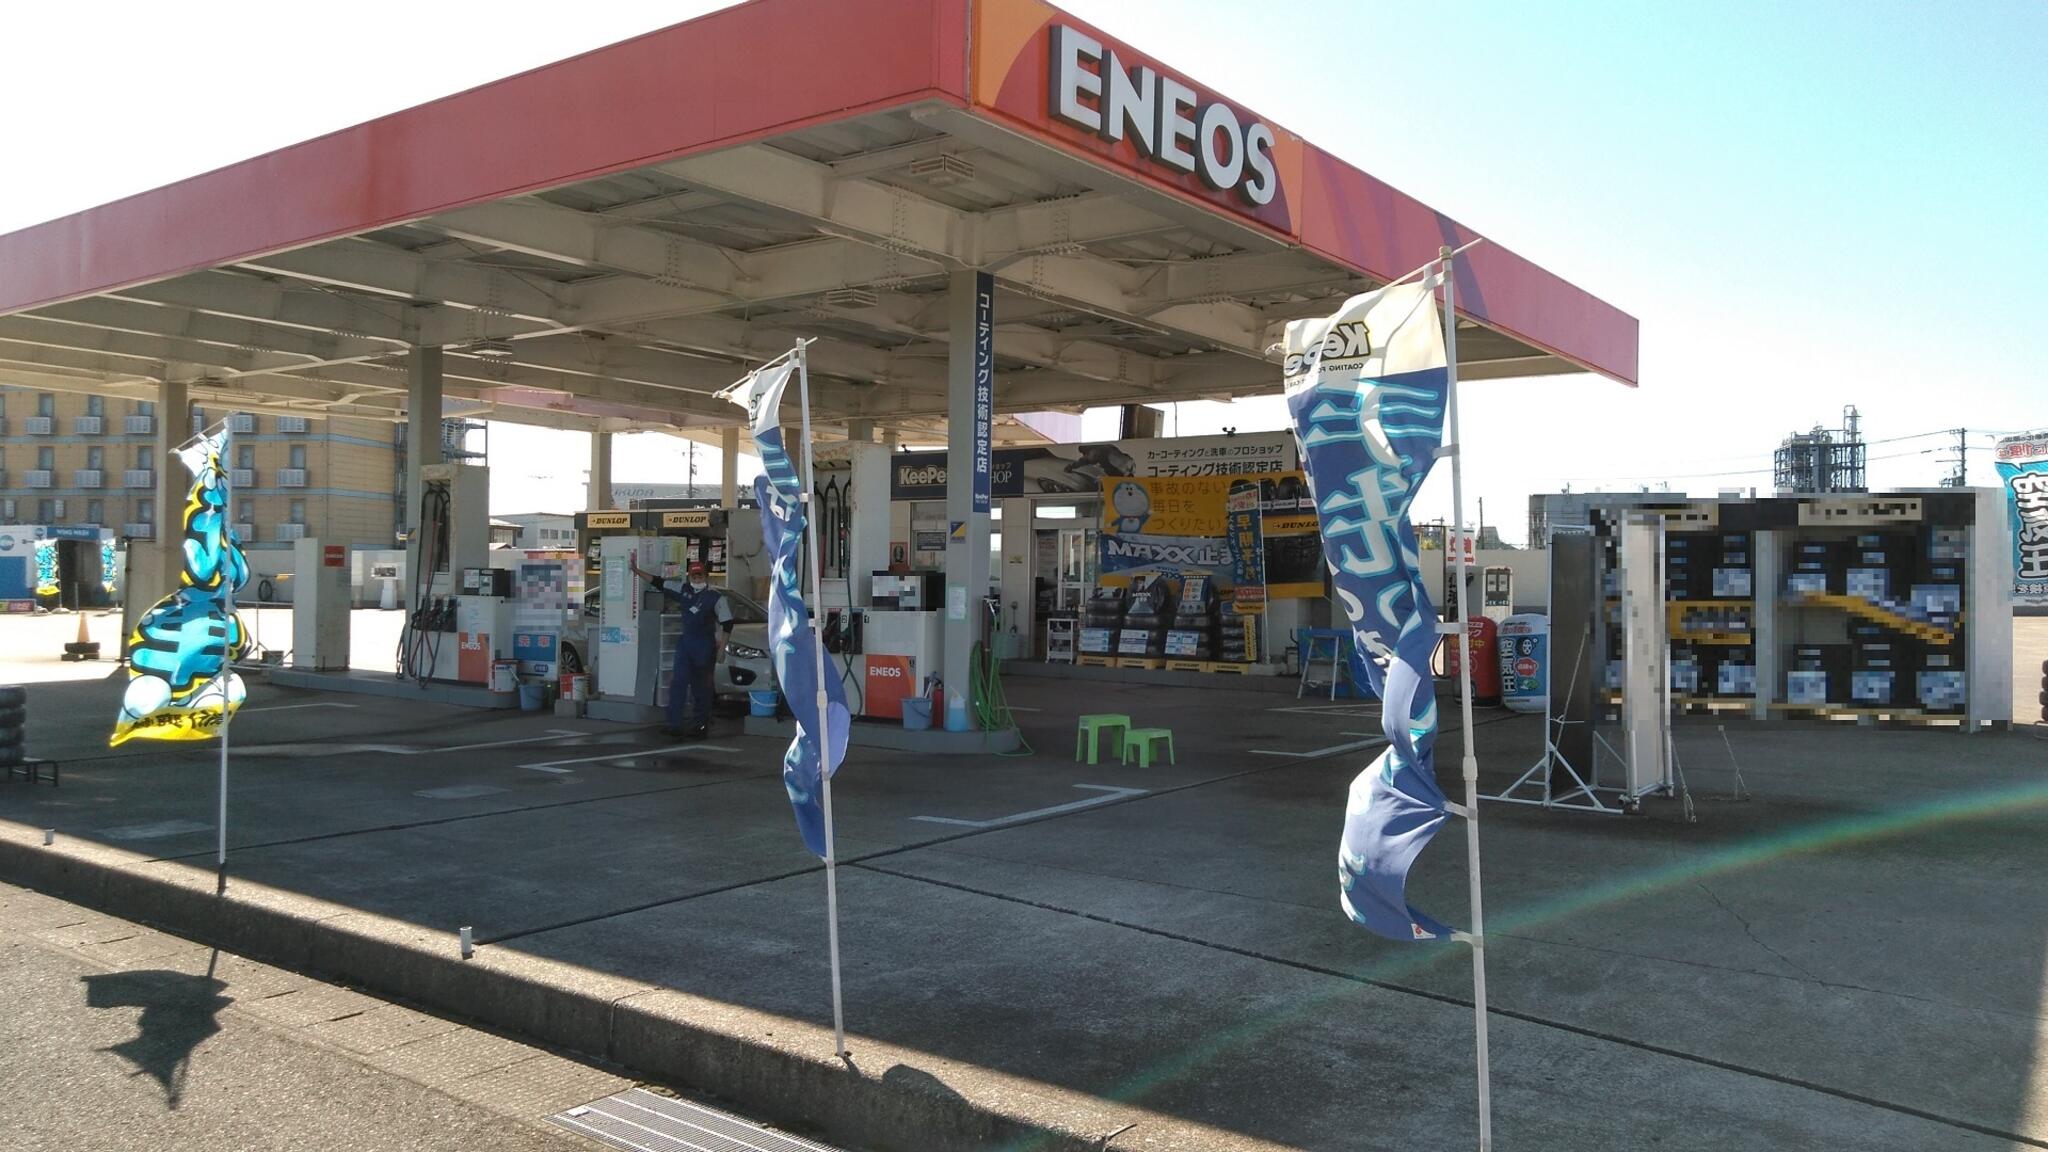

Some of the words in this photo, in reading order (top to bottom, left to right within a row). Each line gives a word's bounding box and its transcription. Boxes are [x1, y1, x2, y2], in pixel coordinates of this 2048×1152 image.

[1053, 24, 1276, 206] ENEOS
[976, 292, 990, 473] コーティング技術認定店
[1147, 444, 1283, 459] カーコーティングと洗車のプロショップ
[900, 465, 947, 485] KeePe
[1147, 460, 1283, 477] コーティング技術認定店
[1151, 481, 1226, 495] 事故のない
[1153, 499, 1195, 513] 毎日を
[595, 517, 628, 525] DUNLOP
[672, 516, 707, 524] DUNLOP
[1151, 518, 1222, 532] つくりたい
[1281, 520, 1318, 529] DUNLO
[1107, 539, 1195, 566] MAXX
[869, 666, 902, 678] ENEOS
[1501, 638, 1516, 693] 空気圧
